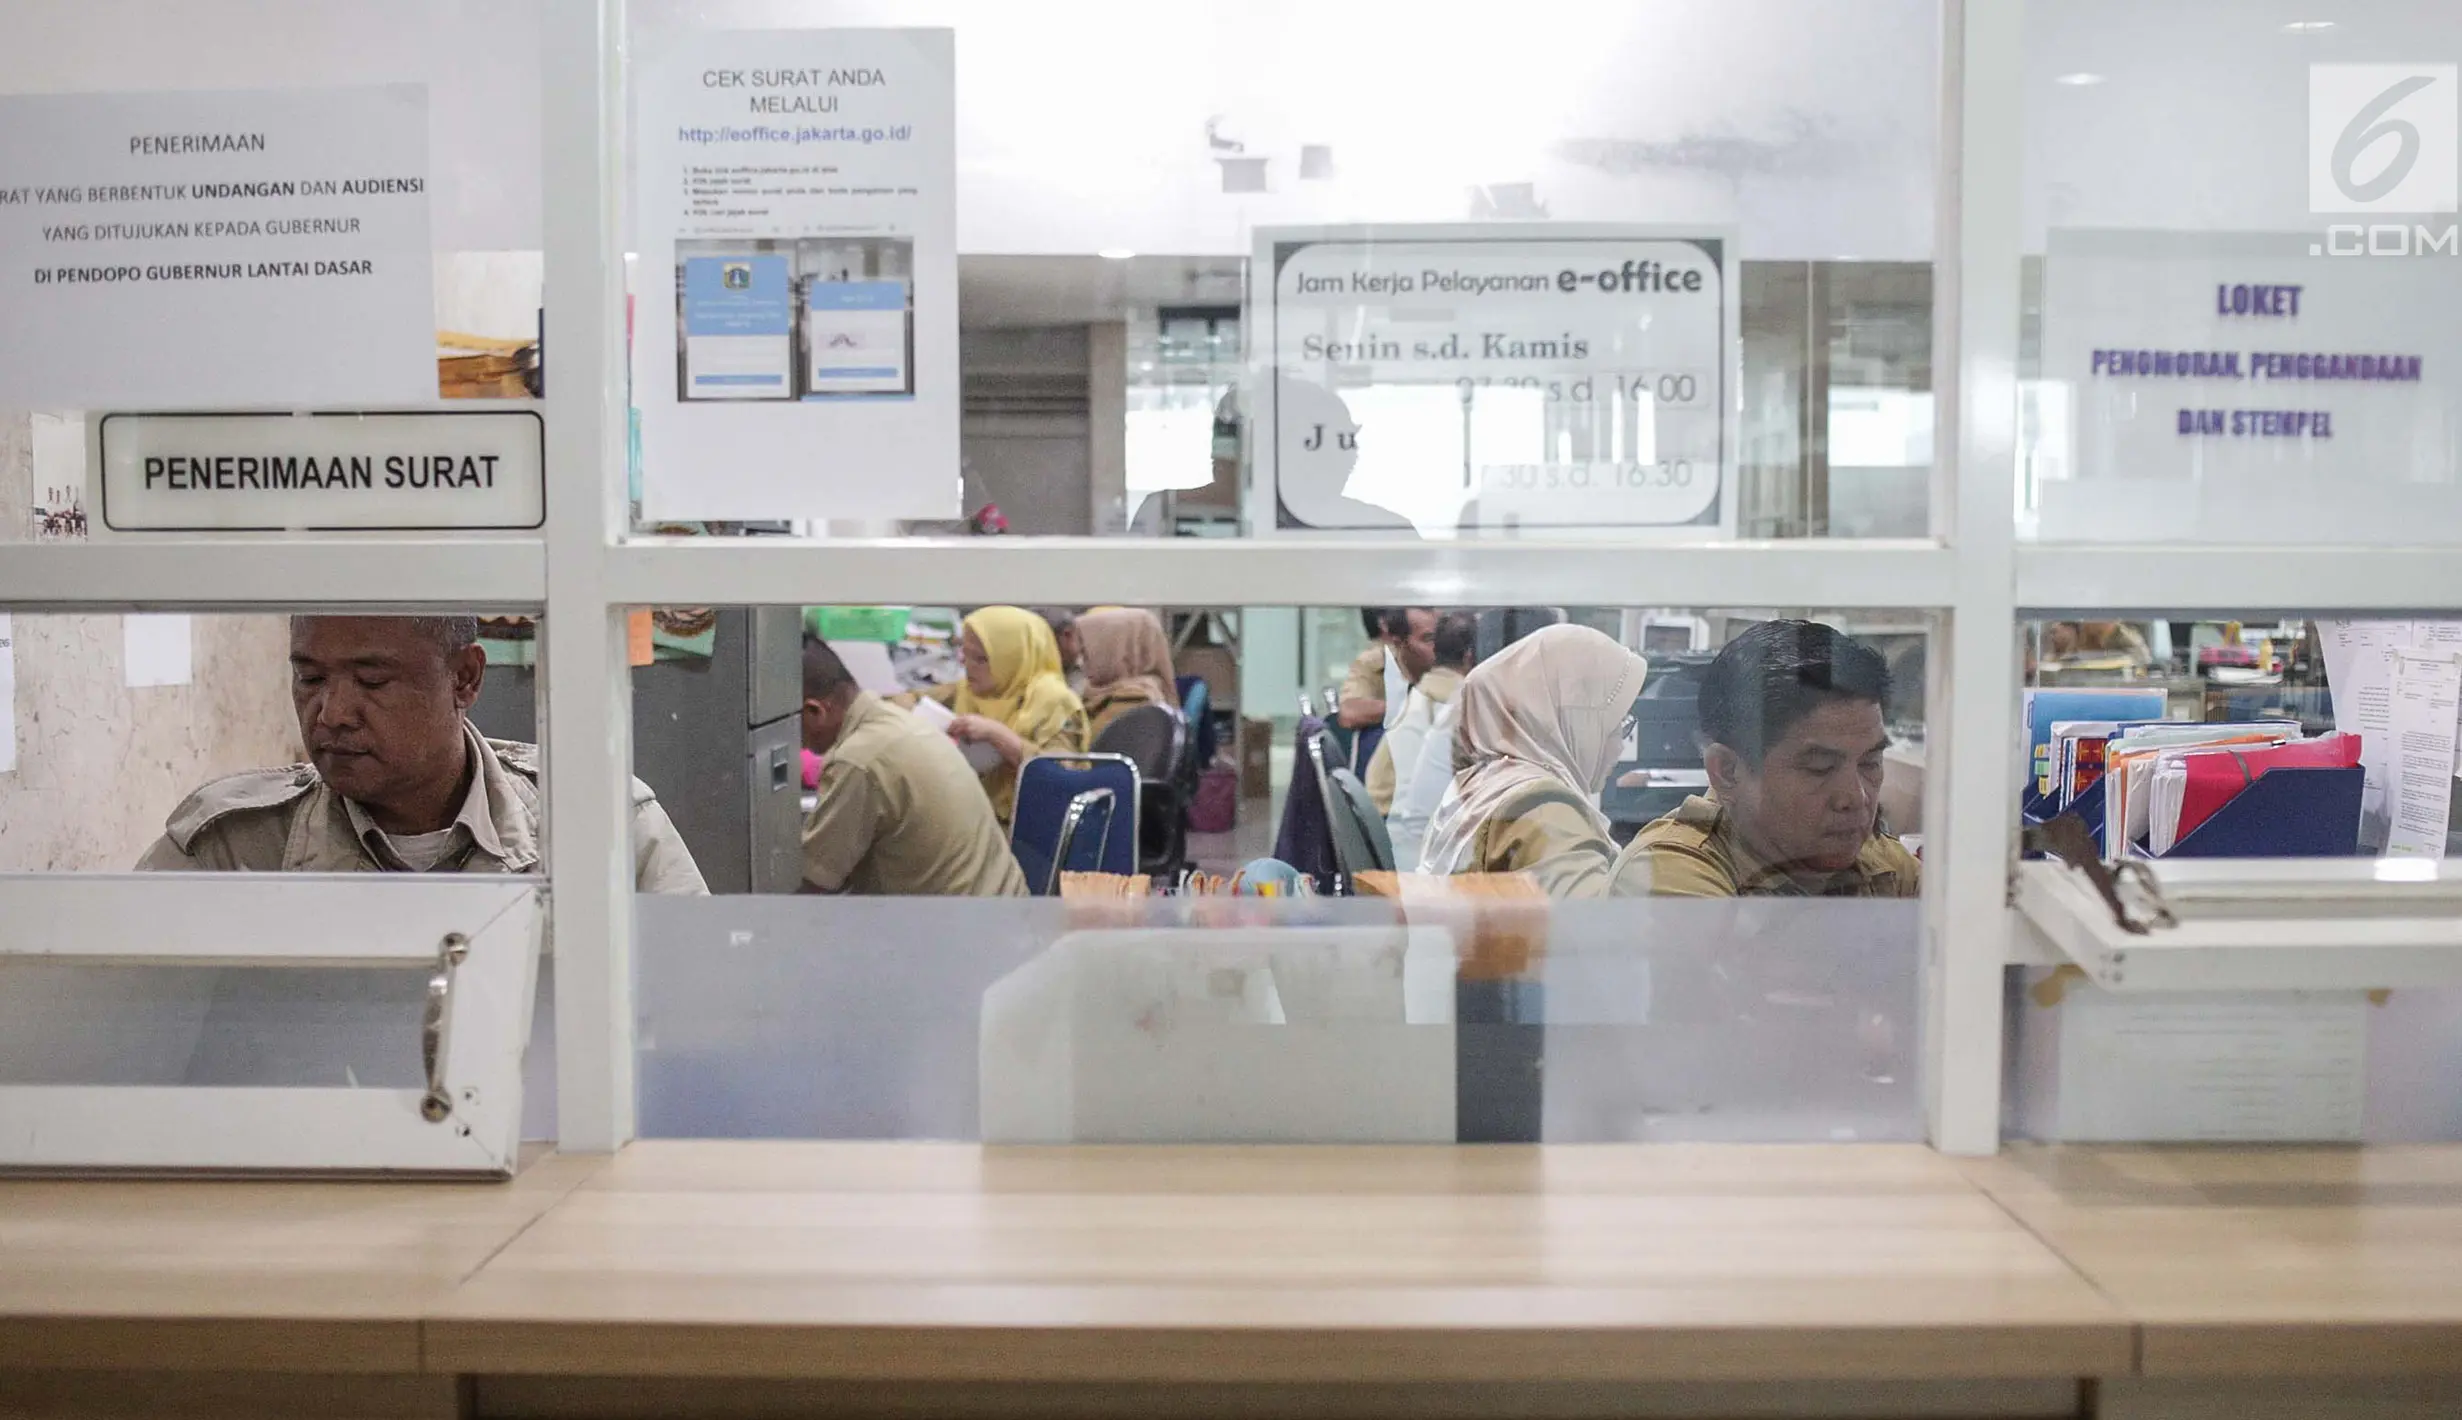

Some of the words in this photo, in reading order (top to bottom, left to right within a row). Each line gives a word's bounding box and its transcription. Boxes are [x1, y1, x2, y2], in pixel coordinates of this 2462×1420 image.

[702, 69, 746, 89] CEK
[751, 68, 822, 88] SURAT
[827, 67, 887, 87] ANDA
[749, 95, 839, 114] MELALUI
[129, 132, 266, 155] PENERIMAAN
[678, 124, 912, 145] http://eoffice.jakarta.go.id/
[34, 186, 83, 205] YANG
[87, 184, 188, 203] BERBENTUK
[191, 181, 296, 200] UNDANGAN
[299, 180, 338, 196] DAN
[341, 177, 425, 195] AUDIENSI
[42, 224, 90, 242] YANG
[93, 221, 190, 241] DITUJUKAN
[193, 219, 262, 238] KEPADA
[264, 217, 362, 236] GUBERNUR
[34, 267, 53, 284] DI
[56, 265, 142, 284] PENDOPO
[145, 263, 243, 282] GUBERNUR
[246, 260, 310, 279] LANTAI
[313, 258, 374, 276] DASAR
[1298, 271, 1345, 294] Jam
[1351, 270, 1415, 297] Kerja
[1421, 269, 1550, 297] Pelayanan
[1556, 260, 1703, 293] e-office
[2217, 283, 2304, 318] LOKET
[1302, 332, 1400, 361] Senin
[1413, 333, 1470, 360] s.d.
[1482, 332, 1590, 360] Kamis
[1616, 373, 1697, 403] 1600
[2176, 407, 2226, 437] DAN
[2231, 409, 2334, 439] STEMPEL
[144, 456, 373, 490] PENERIMAAN
[384, 455, 500, 489] SURAT
